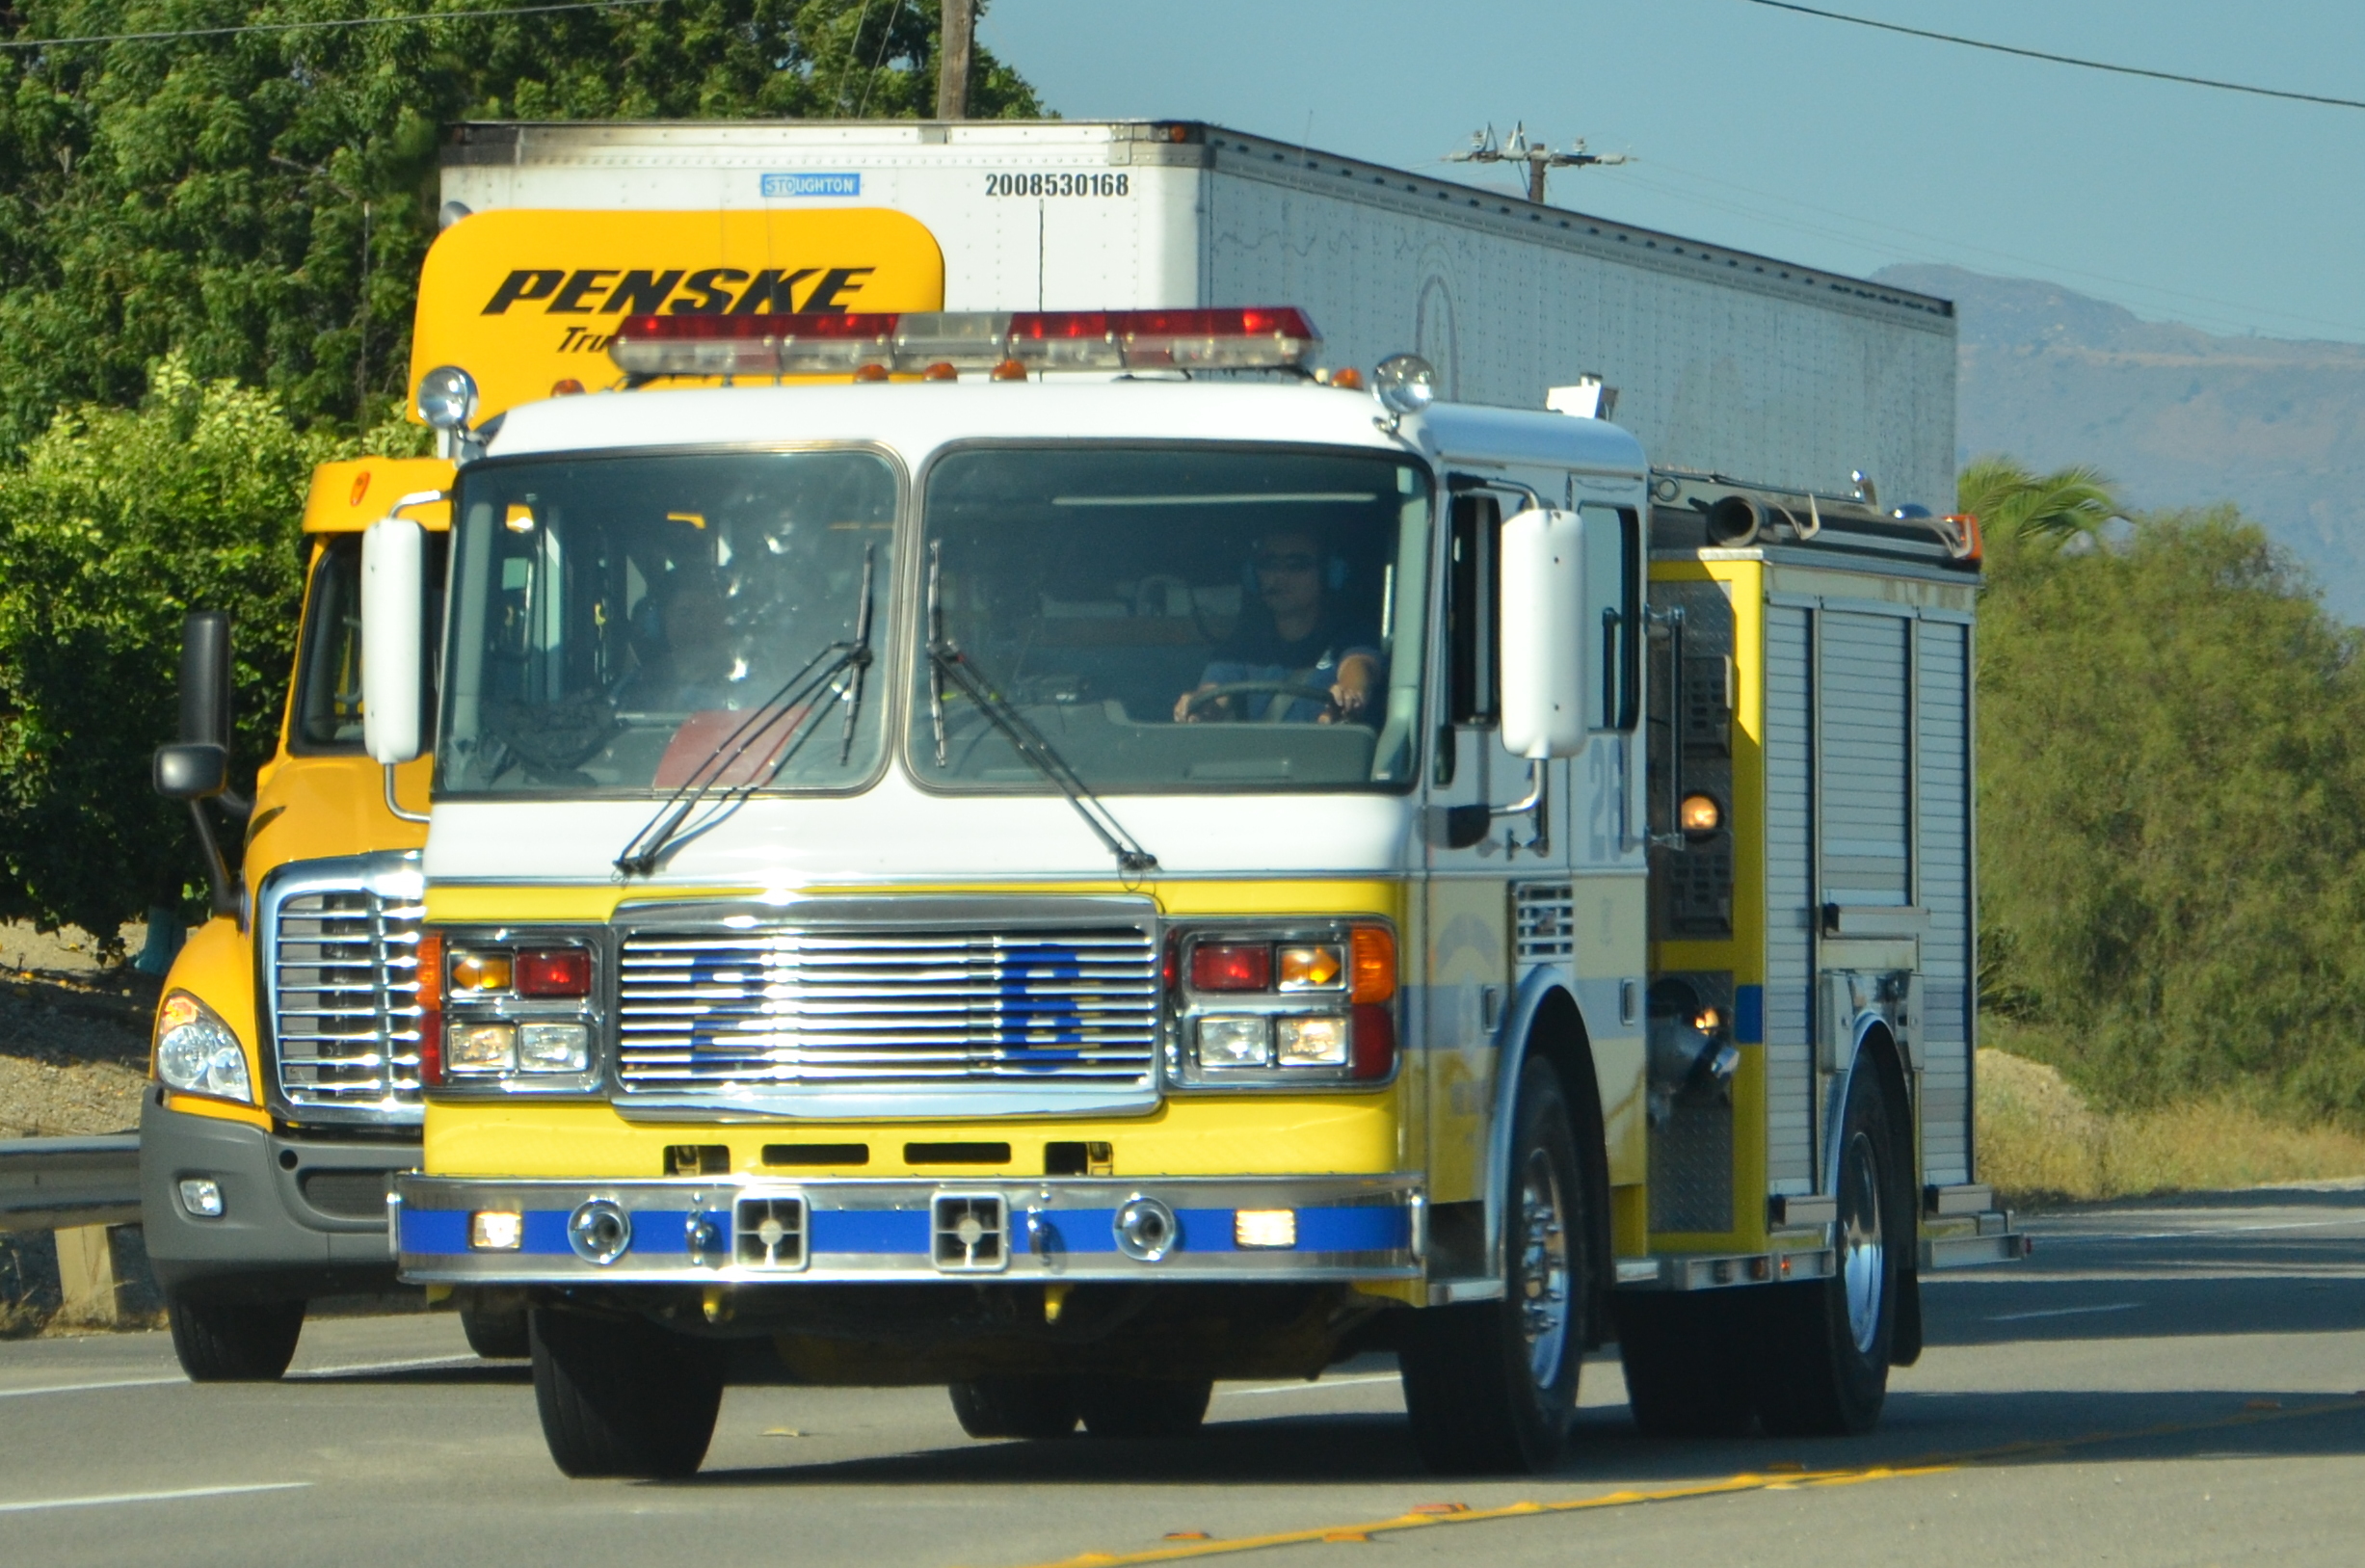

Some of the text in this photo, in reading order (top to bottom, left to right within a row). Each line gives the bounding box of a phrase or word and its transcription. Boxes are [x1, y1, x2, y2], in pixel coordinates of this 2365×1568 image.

[765, 177, 855, 194] STOUGHTON
[985, 173, 1129, 197] 2008530168
[480, 267, 876, 315] PENSKE
